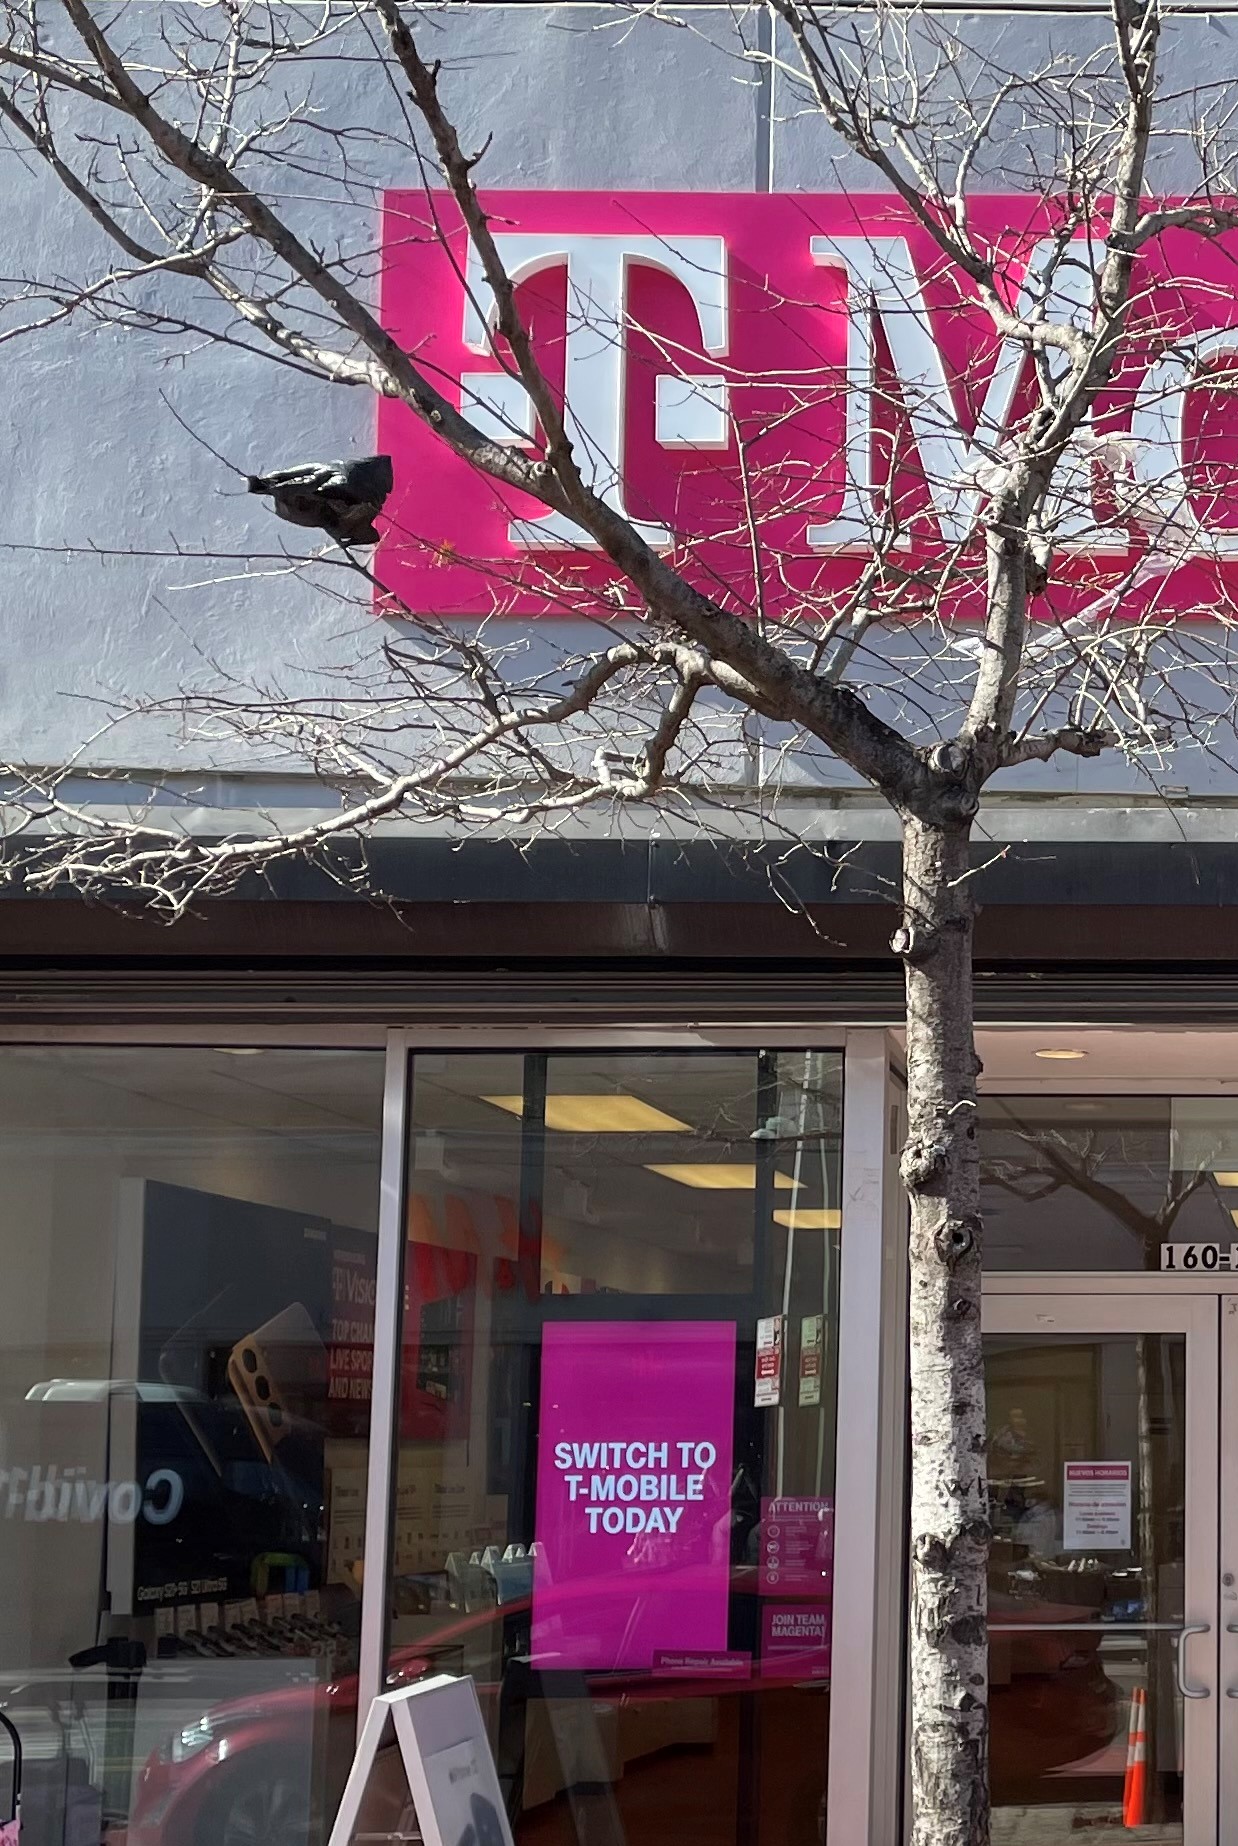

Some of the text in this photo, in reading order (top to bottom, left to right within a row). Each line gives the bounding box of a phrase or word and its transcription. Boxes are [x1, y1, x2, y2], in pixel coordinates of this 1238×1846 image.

[554, 1441, 717, 1470] SWITCH TO
[564, 1474, 704, 1502] T-MOBILE
[585, 1506, 684, 1535] TODAY
[769, 1501, 829, 1512] ATTENTION
[772, 1614, 824, 1625] JOIN TEAM
